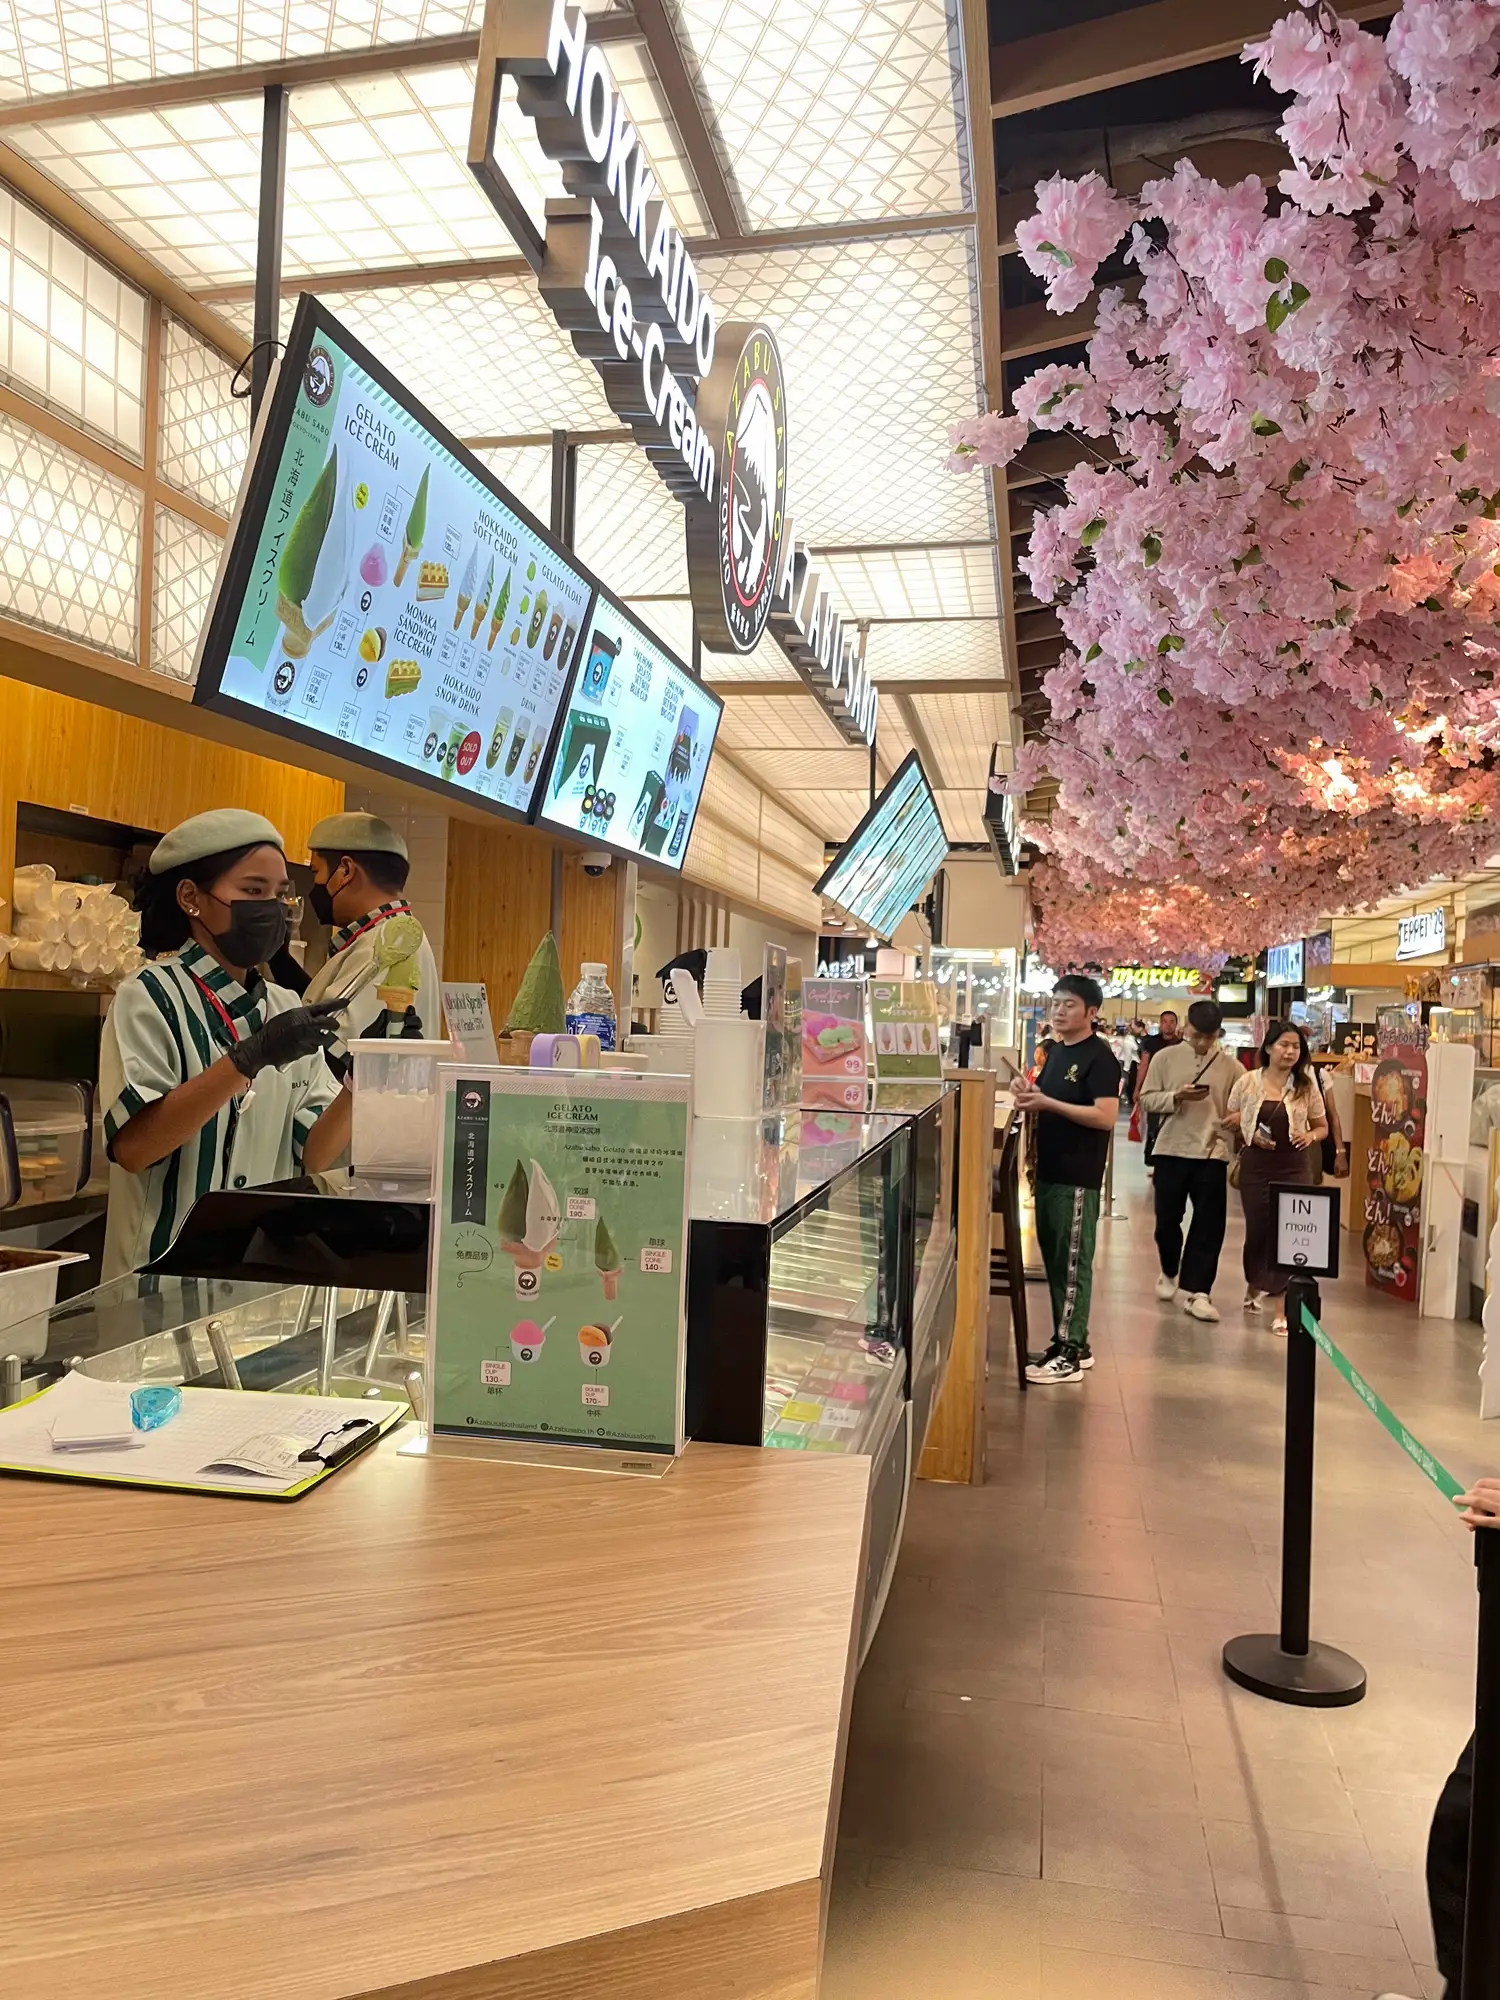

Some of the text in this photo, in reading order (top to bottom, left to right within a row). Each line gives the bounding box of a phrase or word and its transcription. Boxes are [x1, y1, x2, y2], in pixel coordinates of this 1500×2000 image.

[546, 0, 716, 378] HOKKAIDO
[584, 197, 716, 502] Ice-Cream
[296, 408, 310, 422] ABU
[356, 403, 396, 446] GELATO
[344, 415, 399, 471] ICE CREAM
[726, 340, 784, 542] AZABU SABO
[479, 509, 518, 549] HOKKAIDO
[721, 481, 732, 586] TOKYO
[473, 522, 518, 566] SOFT CREAM
[542, 565, 582, 605] GELATO FLOAT
[397, 615, 438, 645] SANDWICH
[405, 602, 437, 631] MONAKA
[393, 629, 406, 644] ICE
[407, 636, 433, 658] CREAM
[435, 686, 480, 717] SNOW DRINK
[442, 673, 482, 702] HOKKAIDO
[521, 697, 536, 713] DRINK
[462, 742, 477, 751] SOLD
[460, 756, 473, 767] OUT
[547, 1112, 598, 1121] ICE CREAM
[554, 1104, 592, 1113] GELATO
[1293, 1199, 1311, 1215] IN
[1285, 1222, 1317, 1233] ทางเข้า
[1292, 1238, 1310, 1246] 入口
